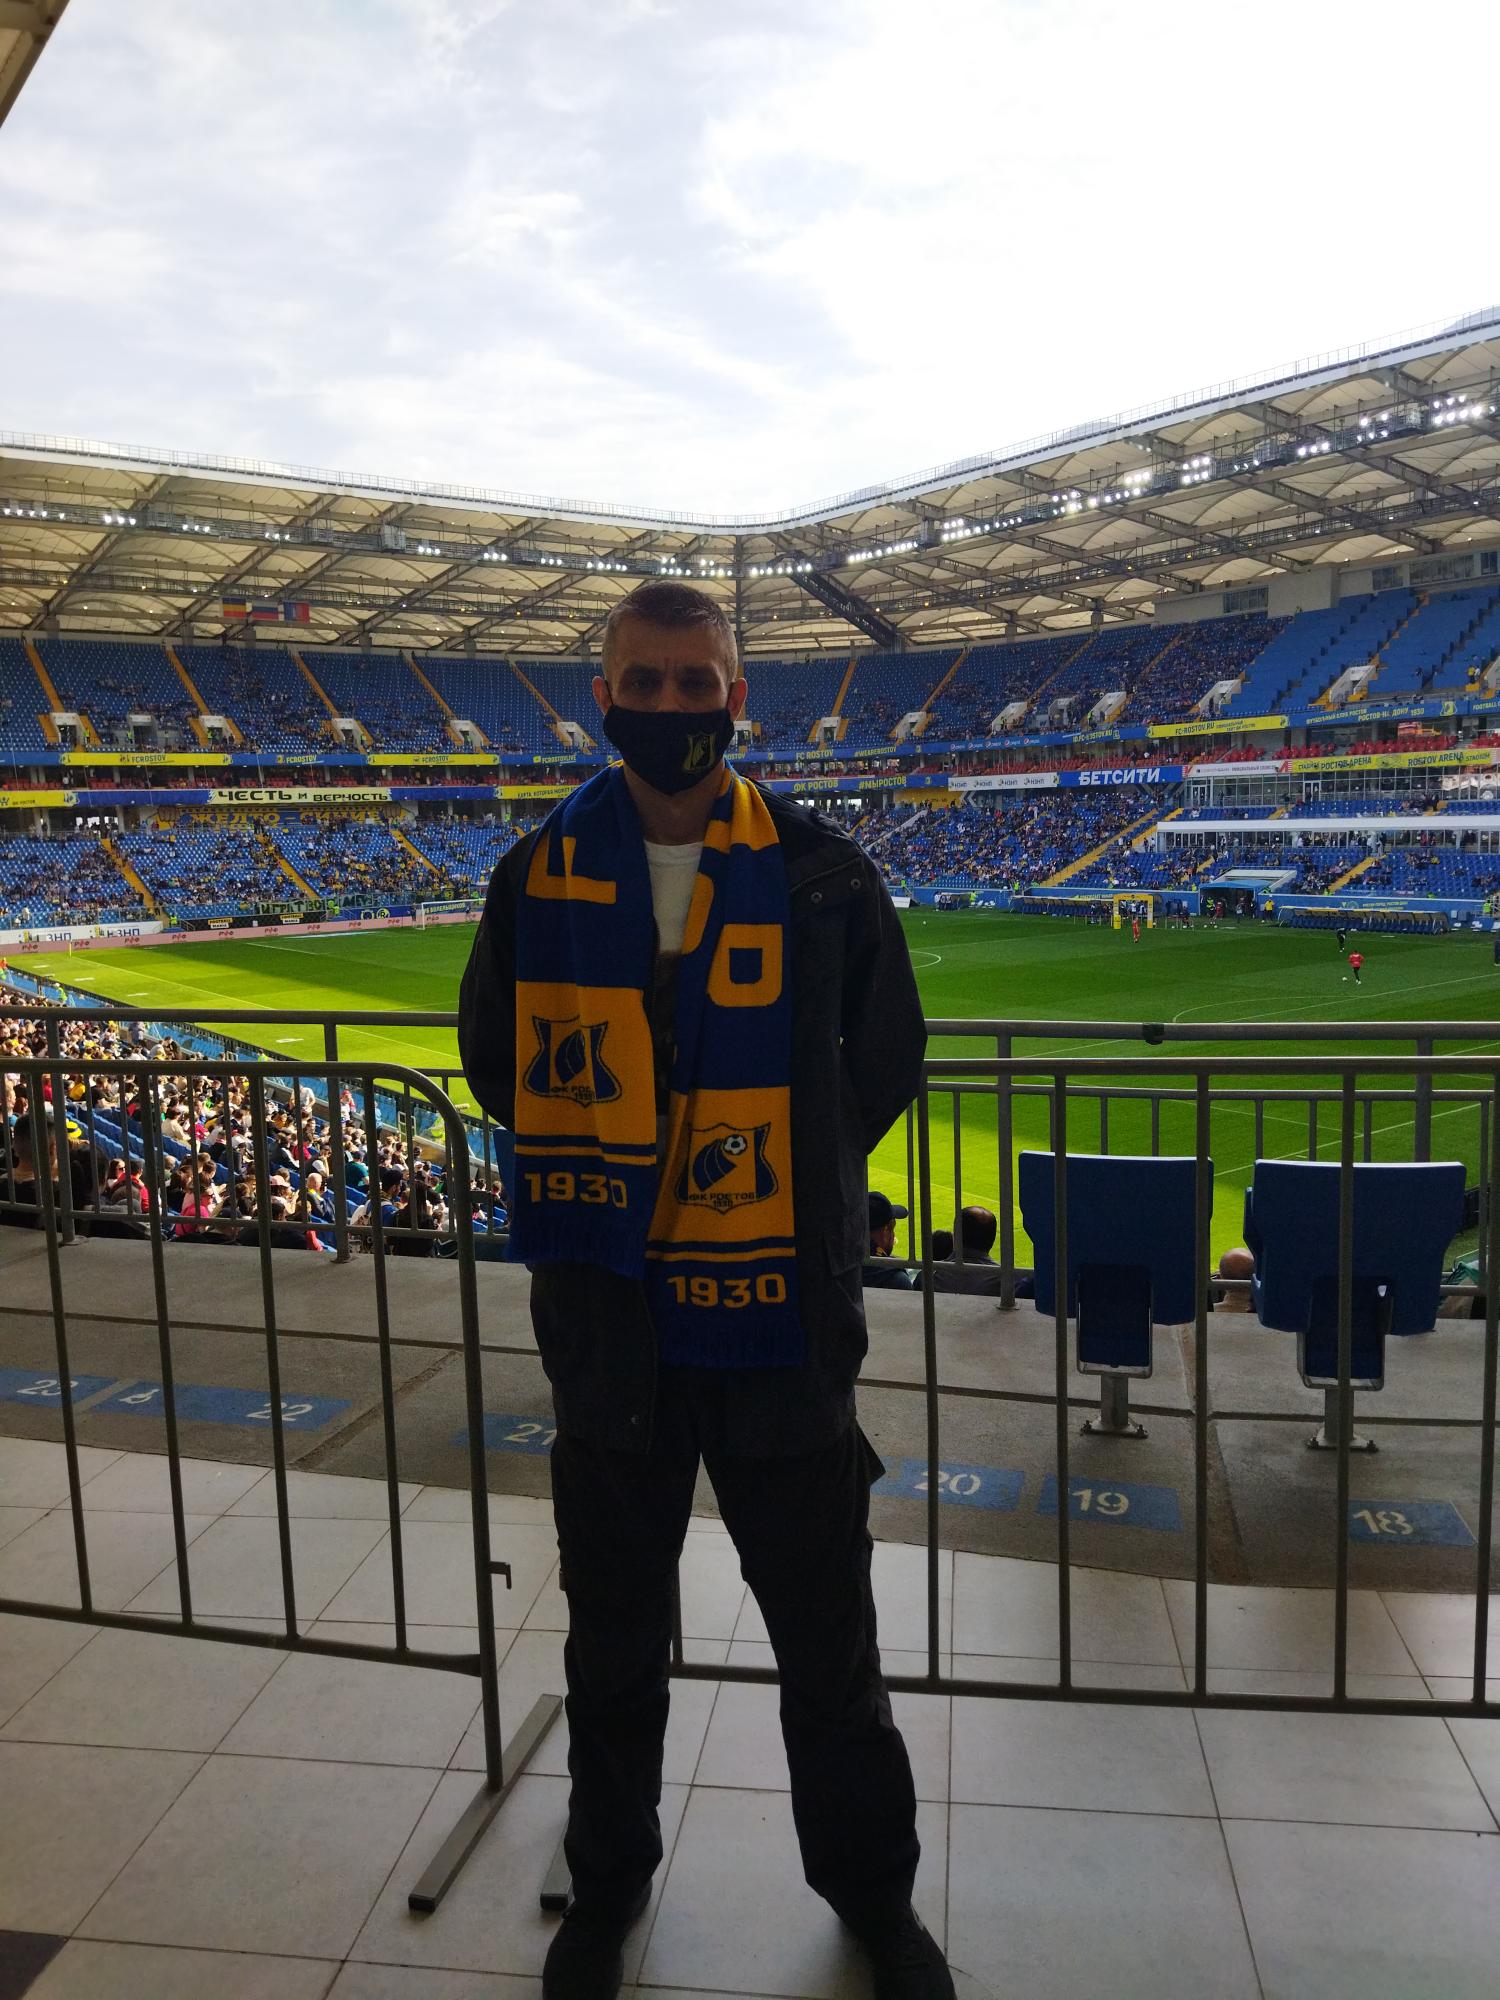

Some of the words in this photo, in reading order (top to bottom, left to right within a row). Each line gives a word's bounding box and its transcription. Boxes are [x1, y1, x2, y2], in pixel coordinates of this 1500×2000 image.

[796, 752, 805, 761] FC
[806, 749, 834, 760] ROSTOV
[1408, 754, 1438, 767] ROSTOV
[1439, 751, 1464, 762] ARENA
[793, 782, 805, 792] ФК
[807, 780, 839, 791] РОСТОВ
[1078, 768, 1161, 786] БЕТСИТИ
[217, 790, 292, 801] ЧЕСТЬ
[313, 793, 389, 802] ВЕРНОСТЬ
[524, 1171, 628, 1209] 1930
[666, 1273, 787, 1309] 1930
[913, 1470, 982, 1497] 20
[1072, 1489, 1130, 1515] 19
[1352, 1509, 1414, 1536] 18
